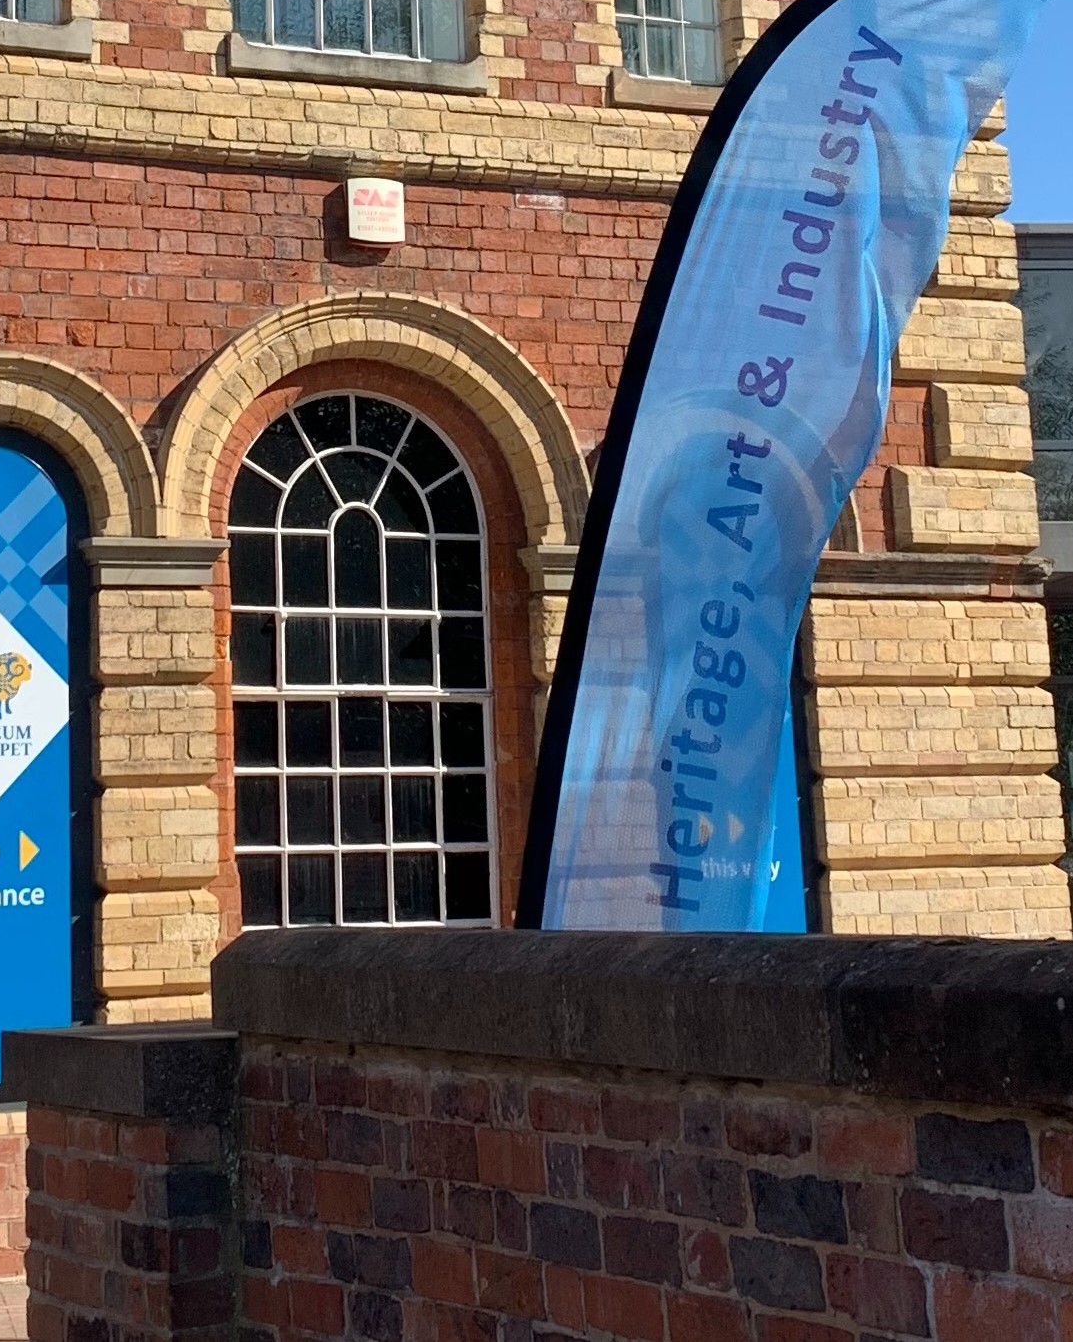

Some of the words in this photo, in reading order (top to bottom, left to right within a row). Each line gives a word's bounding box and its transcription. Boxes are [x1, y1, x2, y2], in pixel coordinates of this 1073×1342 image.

[758, 25, 903, 326] Industry
[737, 356, 794, 407] &
[707, 431, 771, 552] Art
[646, 580, 755, 912] Heritage,
